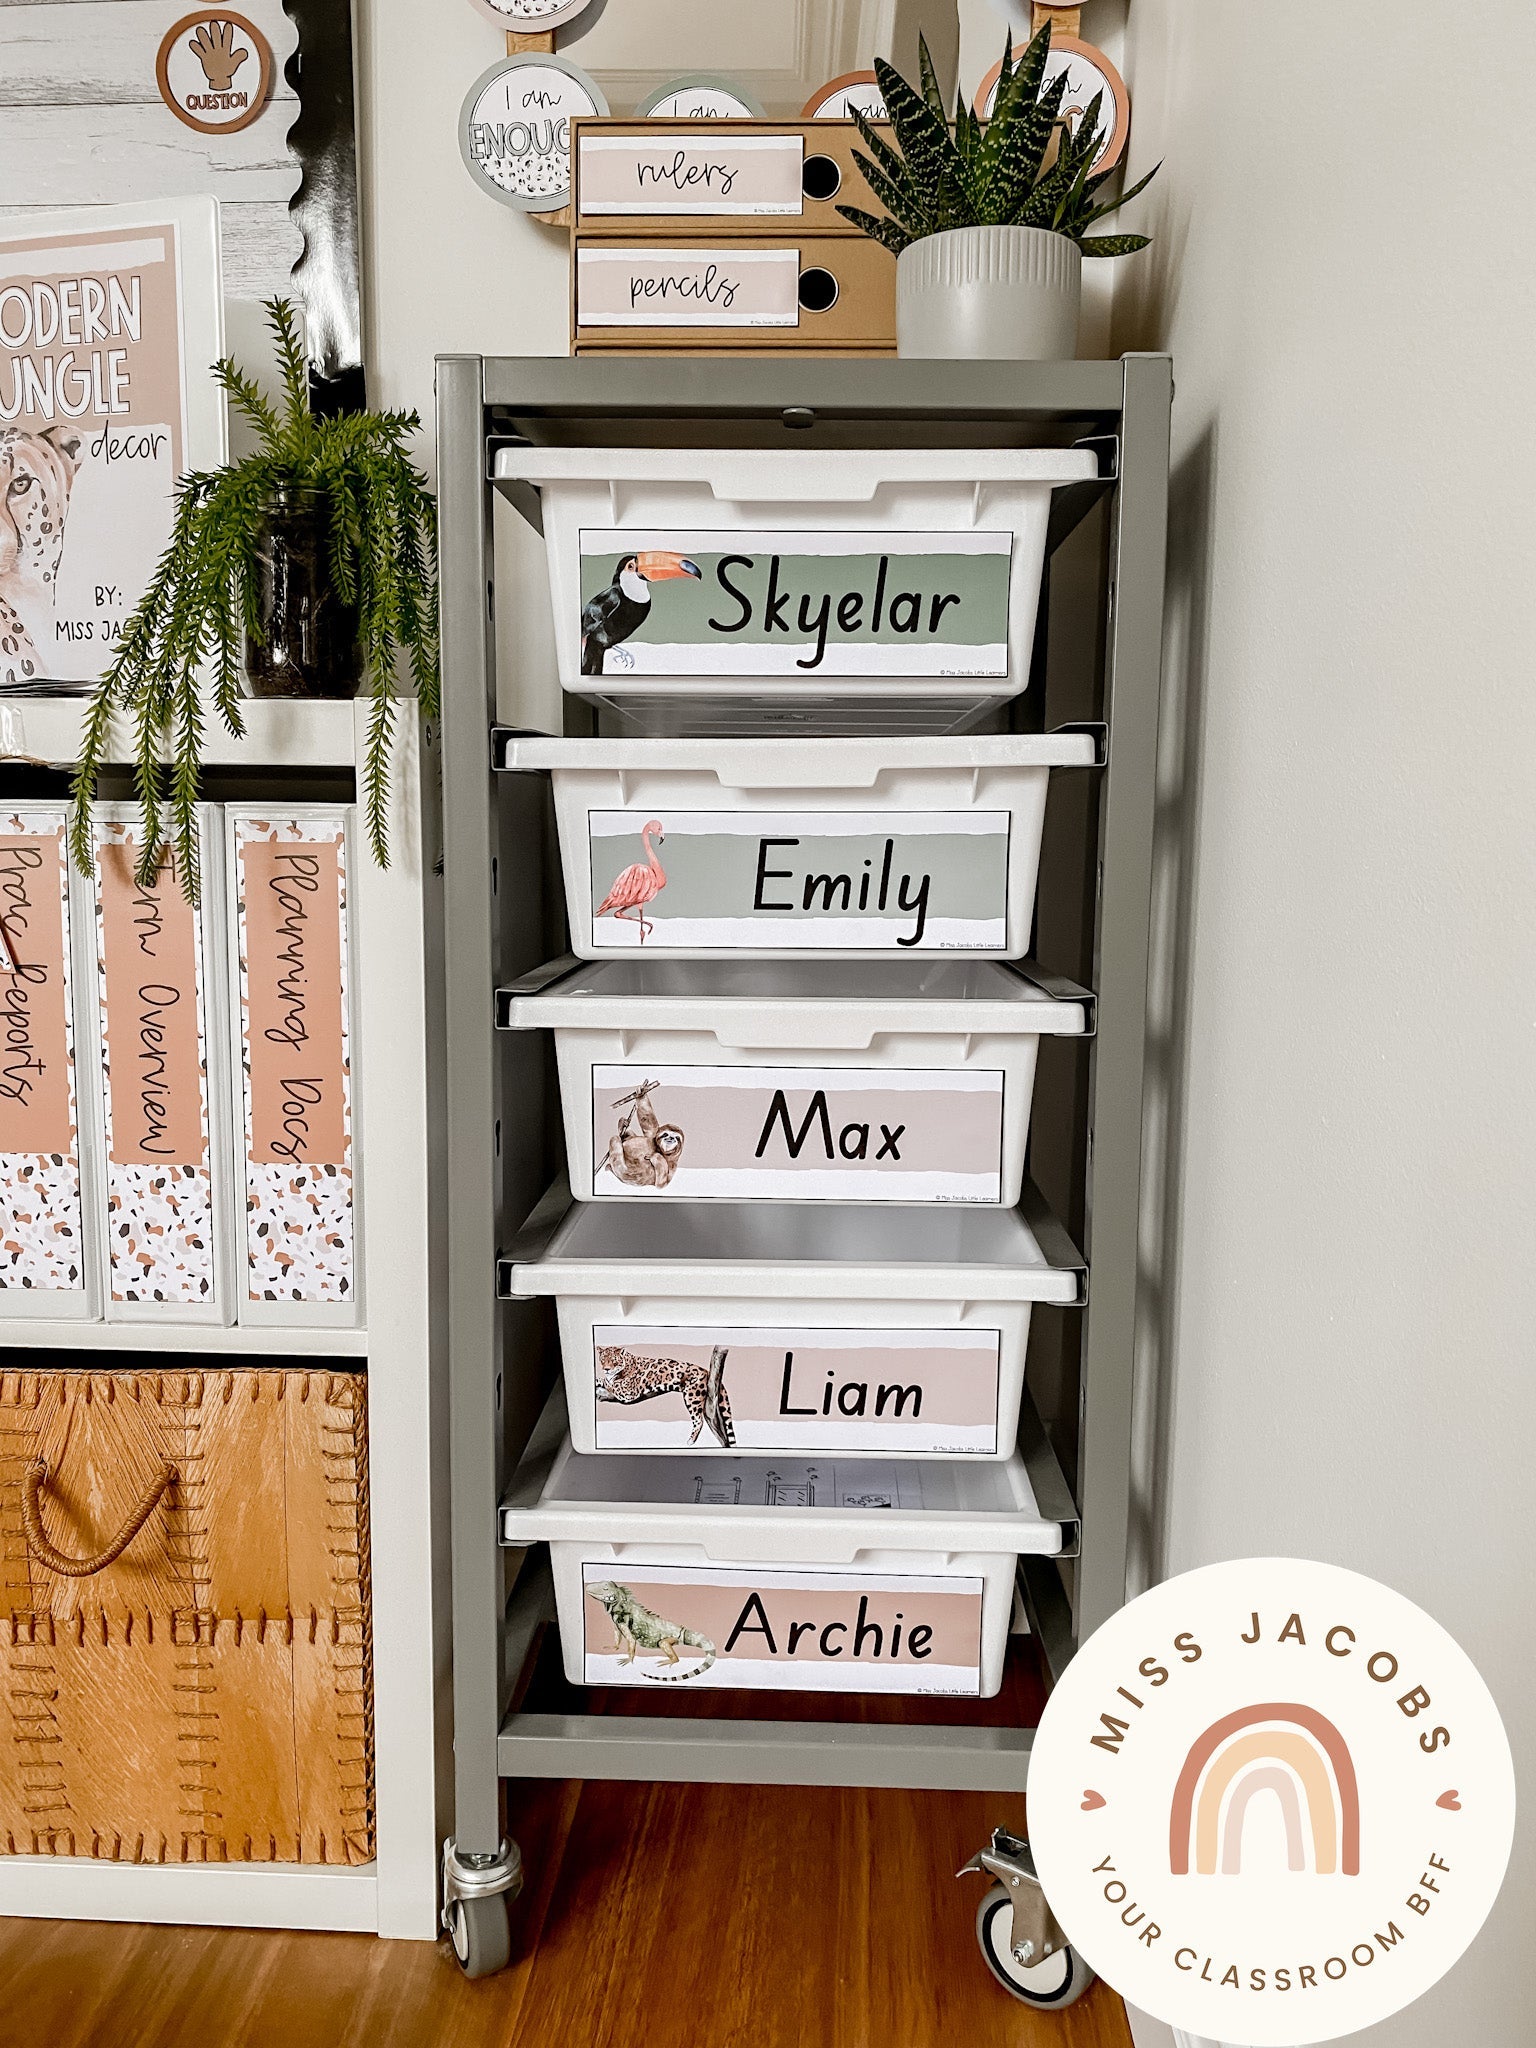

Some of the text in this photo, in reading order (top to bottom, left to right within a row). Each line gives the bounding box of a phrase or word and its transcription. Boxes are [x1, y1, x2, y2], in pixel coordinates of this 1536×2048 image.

[186, 91, 248, 110] QUESTION
[505, 85, 562, 111] I am
[469, 117, 571, 160] ENOUG
[637, 151, 739, 194] rulers
[0, 274, 141, 348] ODERN
[631, 265, 740, 308] pencils
[91, 420, 167, 460] decor
[95, 586, 122, 606] BY:
[708, 555, 960, 669] Skyelar
[56, 621, 94, 641] MISS
[753, 838, 931, 946] Emily
[0, 964, 48, 1107] Reports
[264, 854, 324, 1164] Planning Docs
[139, 984, 181, 1154] Overview
[754, 1089, 906, 1160] Max
[779, 1352, 923, 1417] Liam
[724, 1592, 933, 1659] Archie
